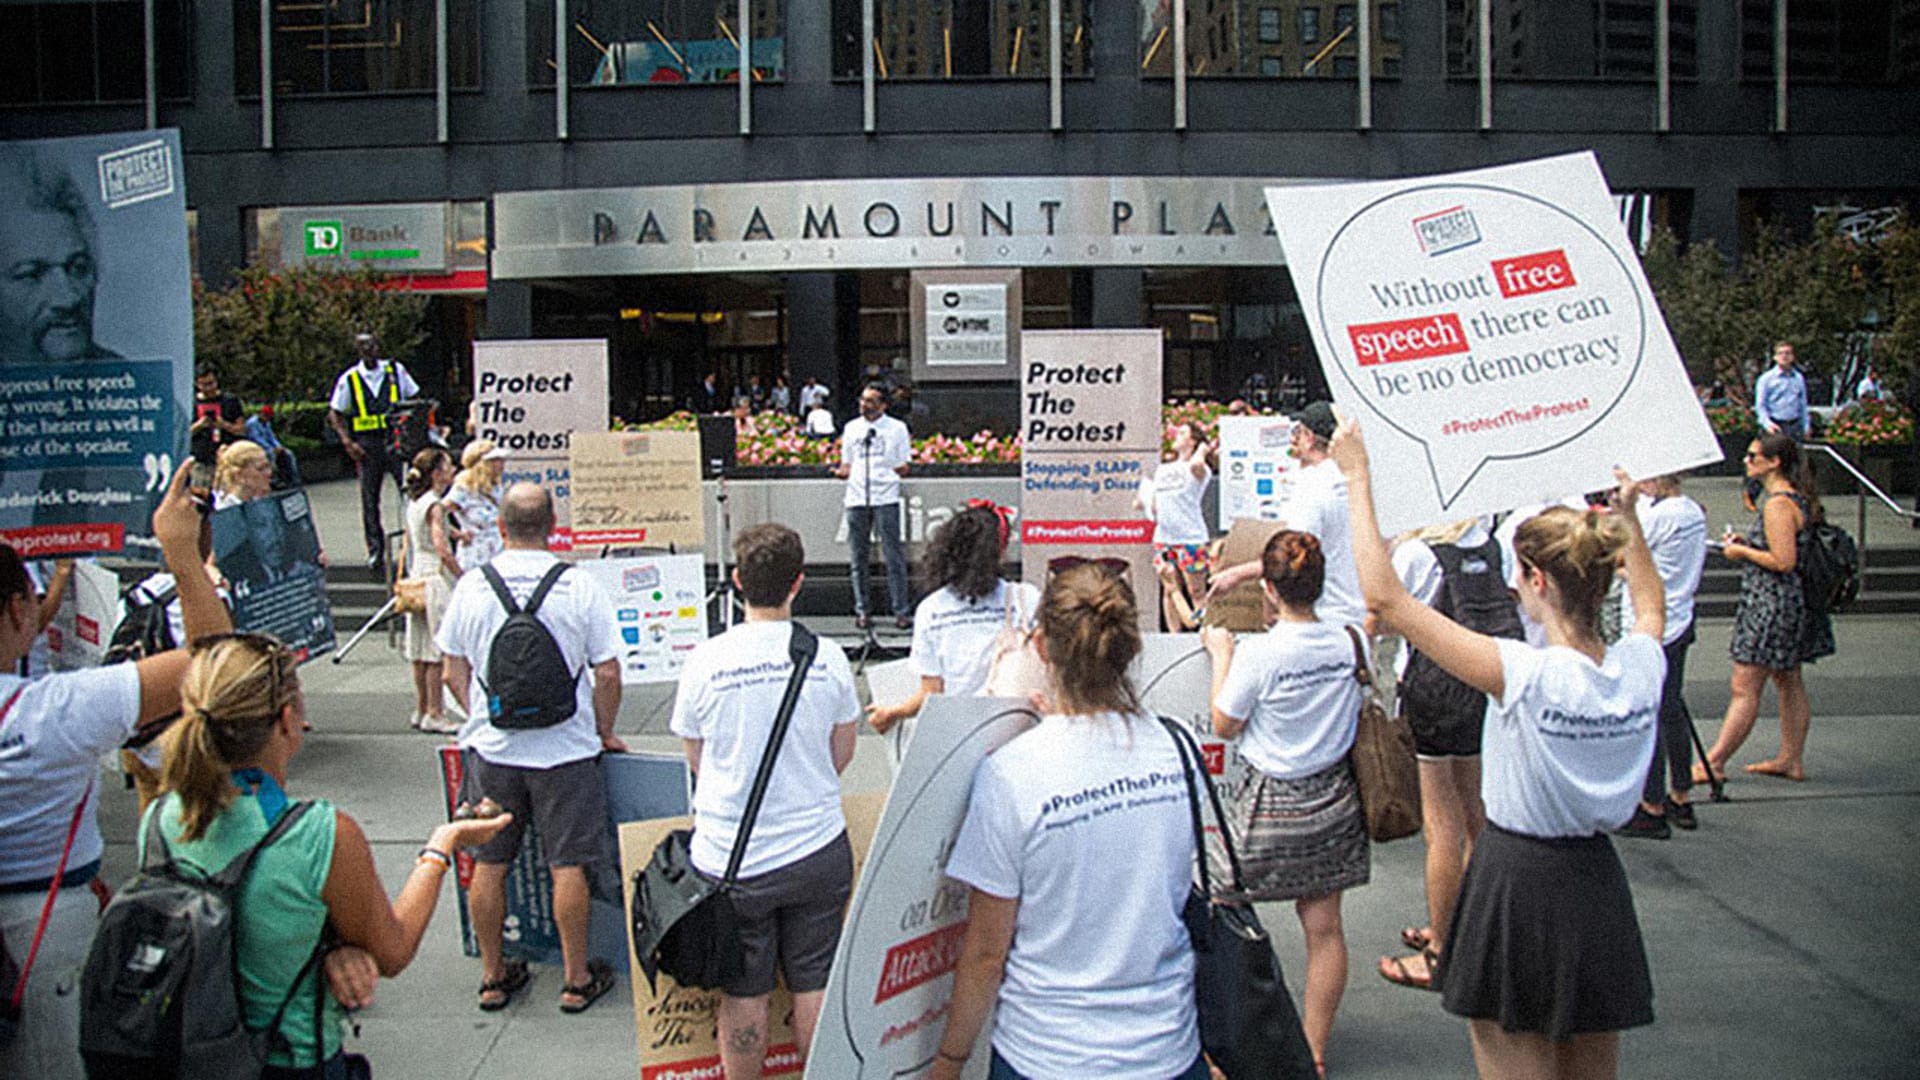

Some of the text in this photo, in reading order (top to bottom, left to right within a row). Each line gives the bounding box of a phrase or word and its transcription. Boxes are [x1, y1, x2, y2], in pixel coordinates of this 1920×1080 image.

[594, 201, 1277, 245] PARAMOUNT PLA
[307, 226, 408, 249] TD Bank
[1370, 261, 1566, 309] Without free
[1356, 296, 1612, 363] speech there can
[1027, 362, 1126, 385] Protect
[1371, 334, 1621, 397] be no democracy
[53, 375, 84, 392] free
[480, 371, 573, 393] Protect
[480, 401, 526, 424] The
[1027, 391, 1076, 415] The
[1442, 396, 1590, 436] #ProtectTheProtest
[1027, 420, 1126, 442] Protest
[1026, 461, 1090, 477] Stopping
[1025, 478, 1100, 493] Defending
